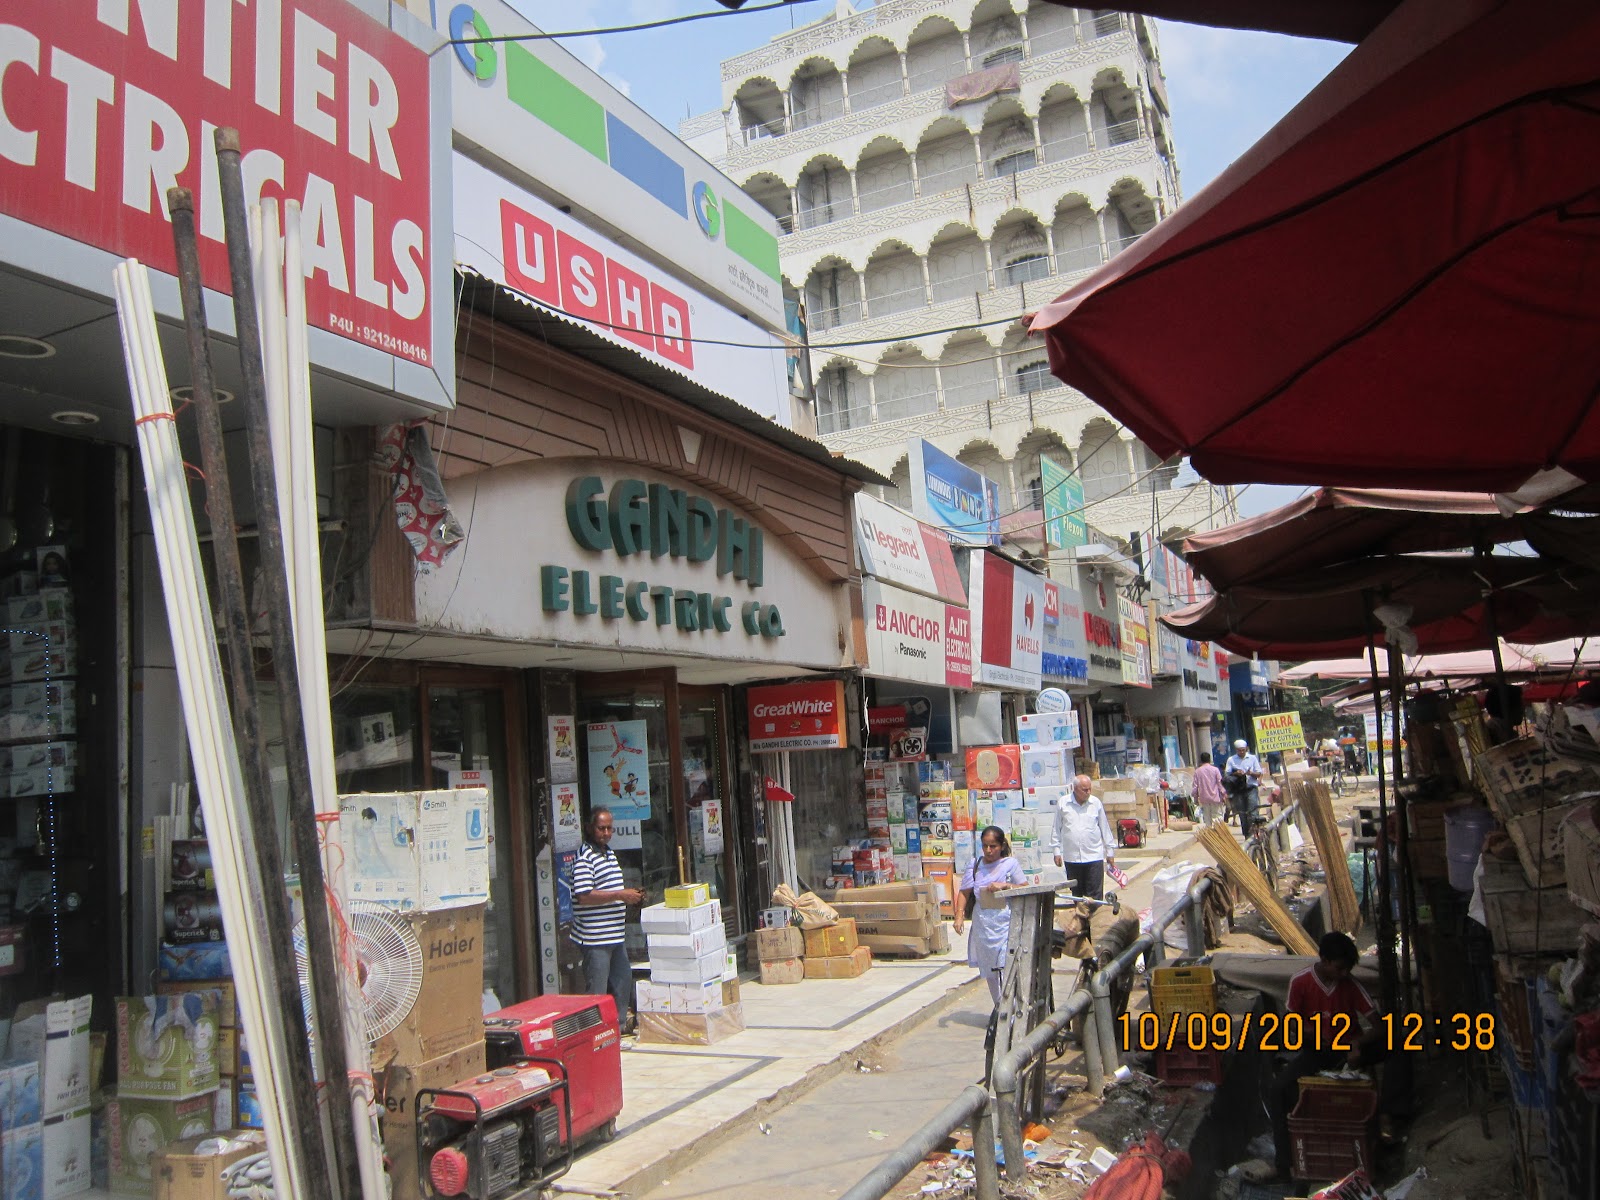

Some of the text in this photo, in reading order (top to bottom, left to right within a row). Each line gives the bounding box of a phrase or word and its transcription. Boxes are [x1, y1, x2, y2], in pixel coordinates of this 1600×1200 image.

[514, 222, 685, 353] USHA
[329, 313, 354, 334] P4U
[363, 327, 428, 362] 9212418416
[565, 476, 763, 587] GANDHI
[873, 523, 920, 560] legrand
[541, 565, 732, 632] ELECTRIC
[1044, 588, 1058, 612] CM
[889, 610, 940, 643] ANCHOR
[949, 616, 968, 637] AJIT
[900, 643, 927, 660] Panasonic
[1016, 634, 1040, 655] HAVELLS
[753, 700, 833, 718] GreatWhite
[1260, 715, 1294, 730] KALRA
[429, 936, 475, 959] Haier
